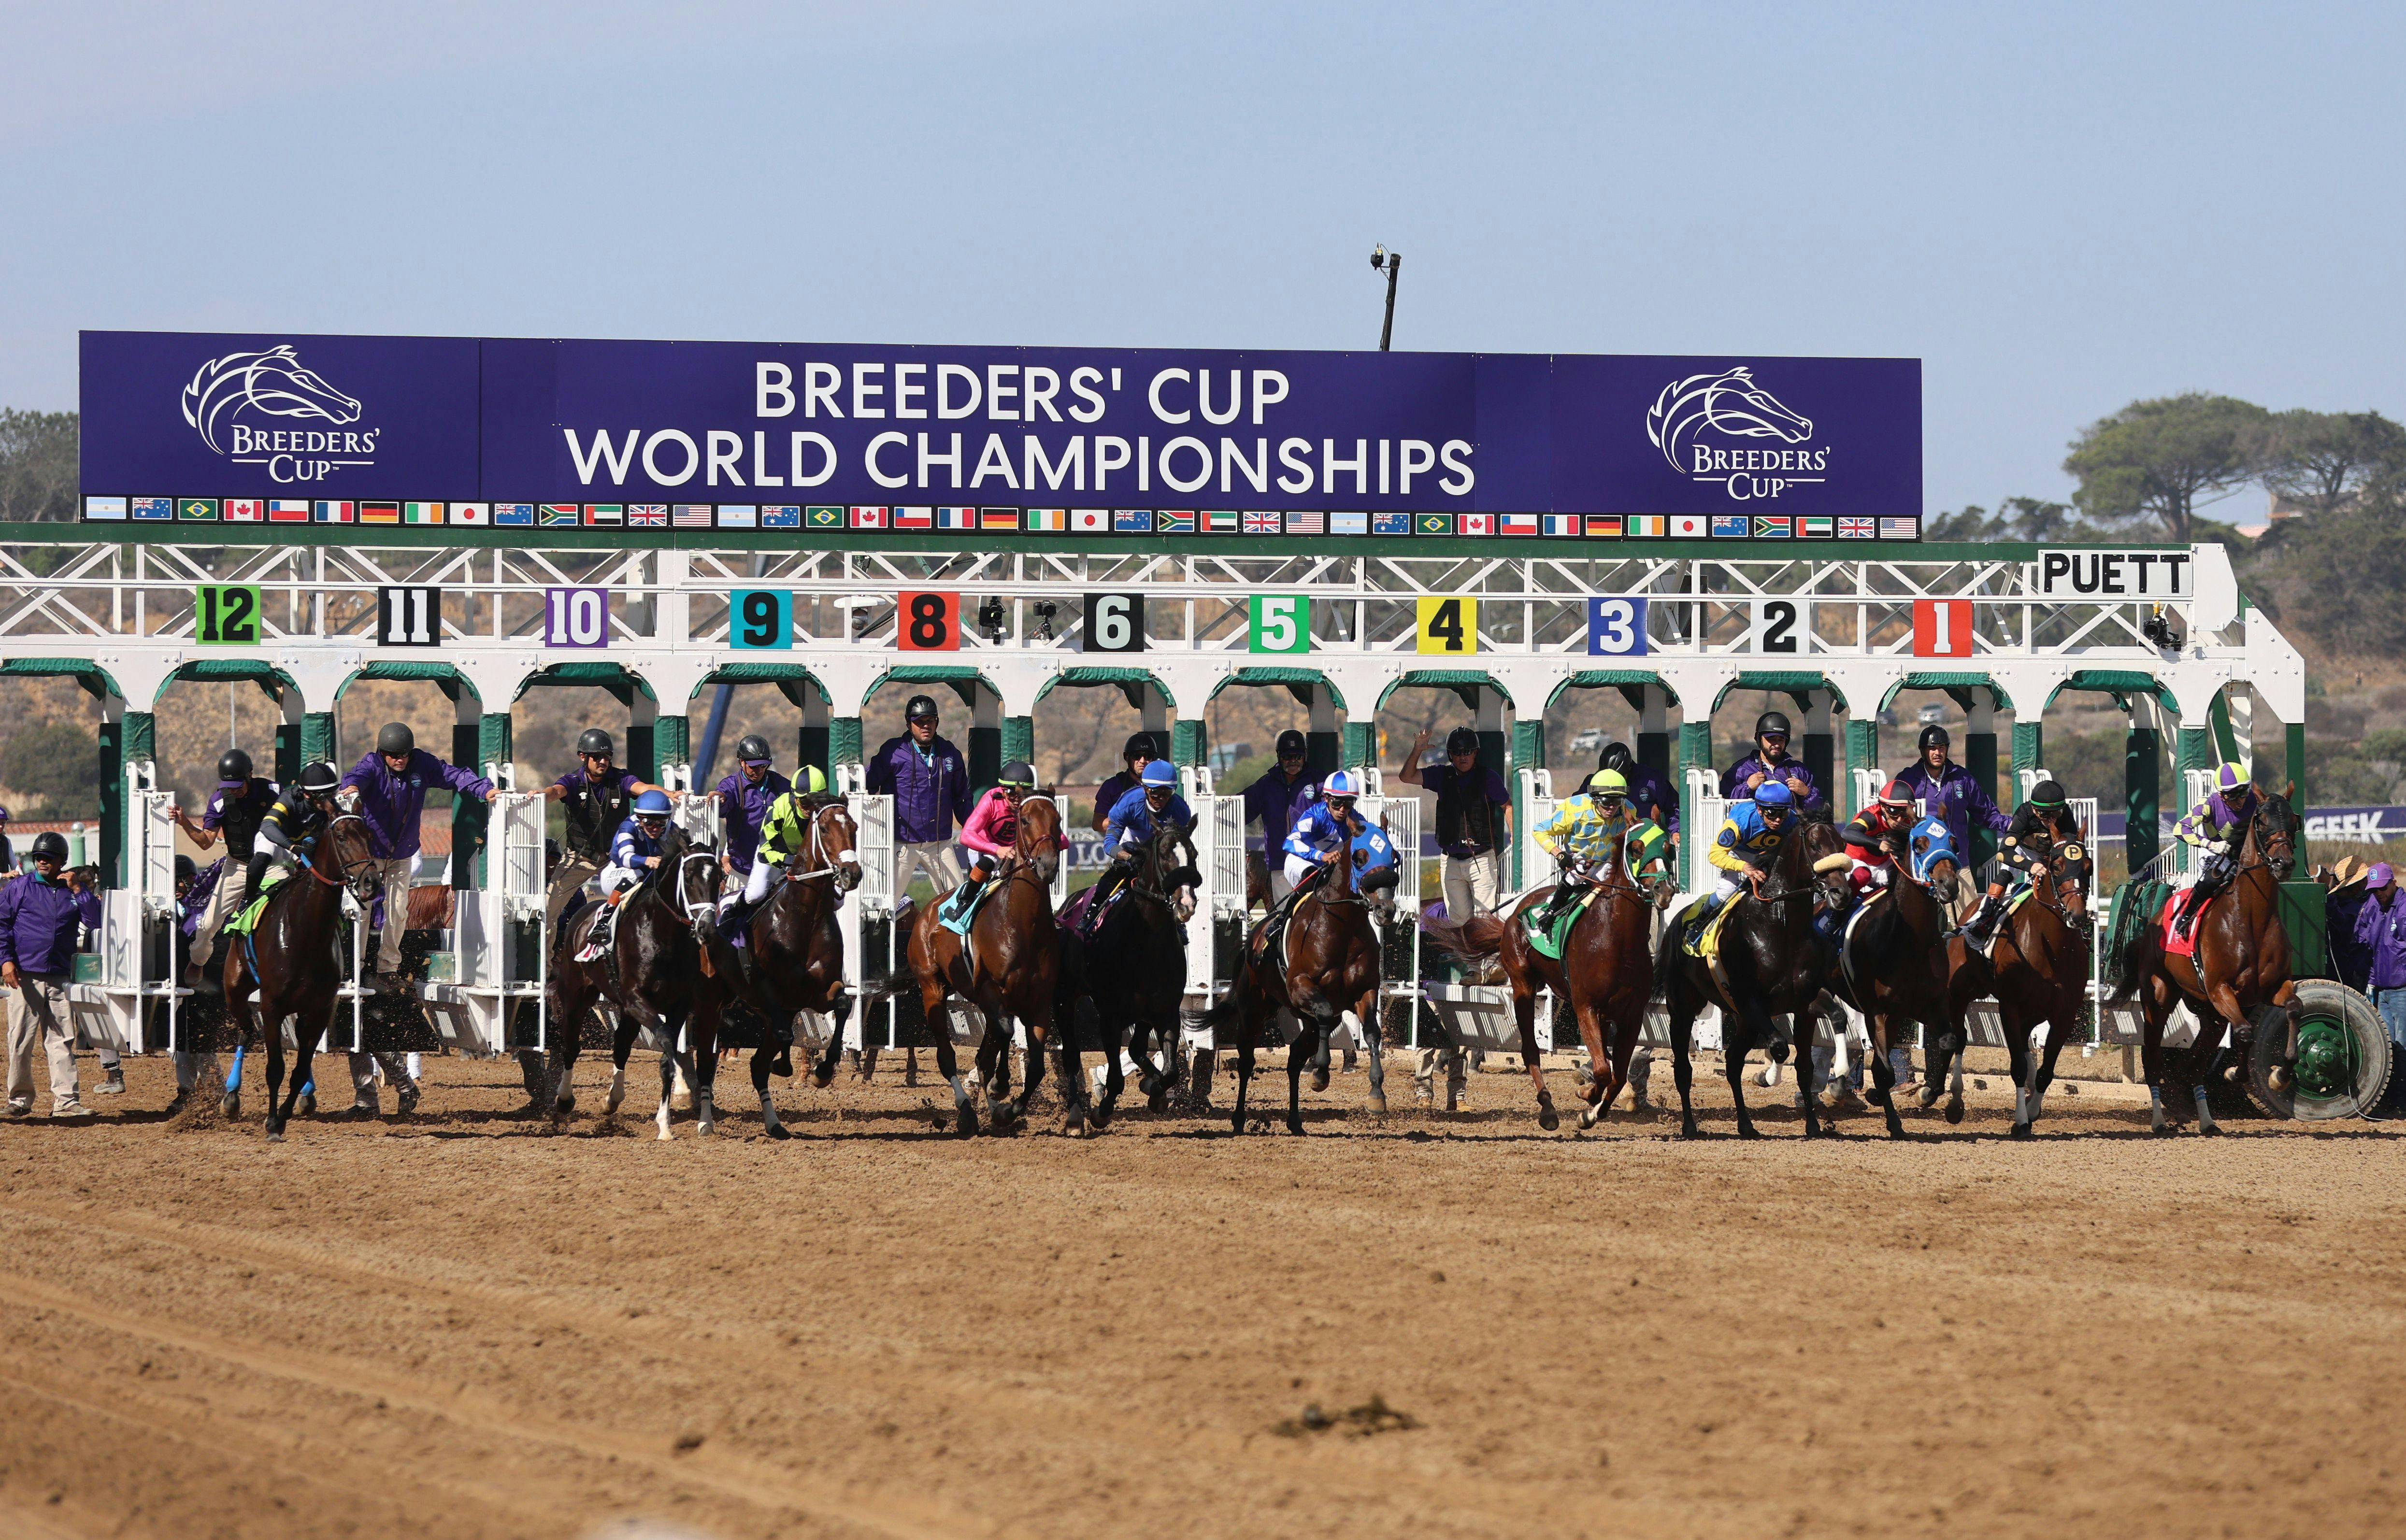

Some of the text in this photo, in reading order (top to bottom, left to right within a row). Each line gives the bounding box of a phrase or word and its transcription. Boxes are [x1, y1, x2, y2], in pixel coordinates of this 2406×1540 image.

[757, 362, 1289, 425] BREEDERS' CUP
[231, 425, 380, 454] BREEDERS'
[563, 429, 1475, 496] WORLD CHAMPIONSHIPS
[1692, 444, 1830, 472] BREEDERS'
[269, 454, 331, 483] CUP
[1727, 473, 1785, 500] CUP
[2044, 553, 2190, 594] PUETT
[203, 587, 253, 641] 12
[388, 589, 430, 642] 11
[552, 590, 601, 644] 10
[743, 592, 778, 646] 9
[910, 594, 946, 648] 8
[1096, 595, 1131, 649] 6
[1261, 598, 1296, 650] 5
[1429, 599, 1463, 651] 4
[1600, 599, 1634, 653] 3
[1763, 601, 1796, 653] 2
[1934, 602, 1951, 653] 1
[2069, 847, 2079, 858] P
[2305, 810, 2384, 844] GEEK
[1075, 842, 1113, 866] LO
